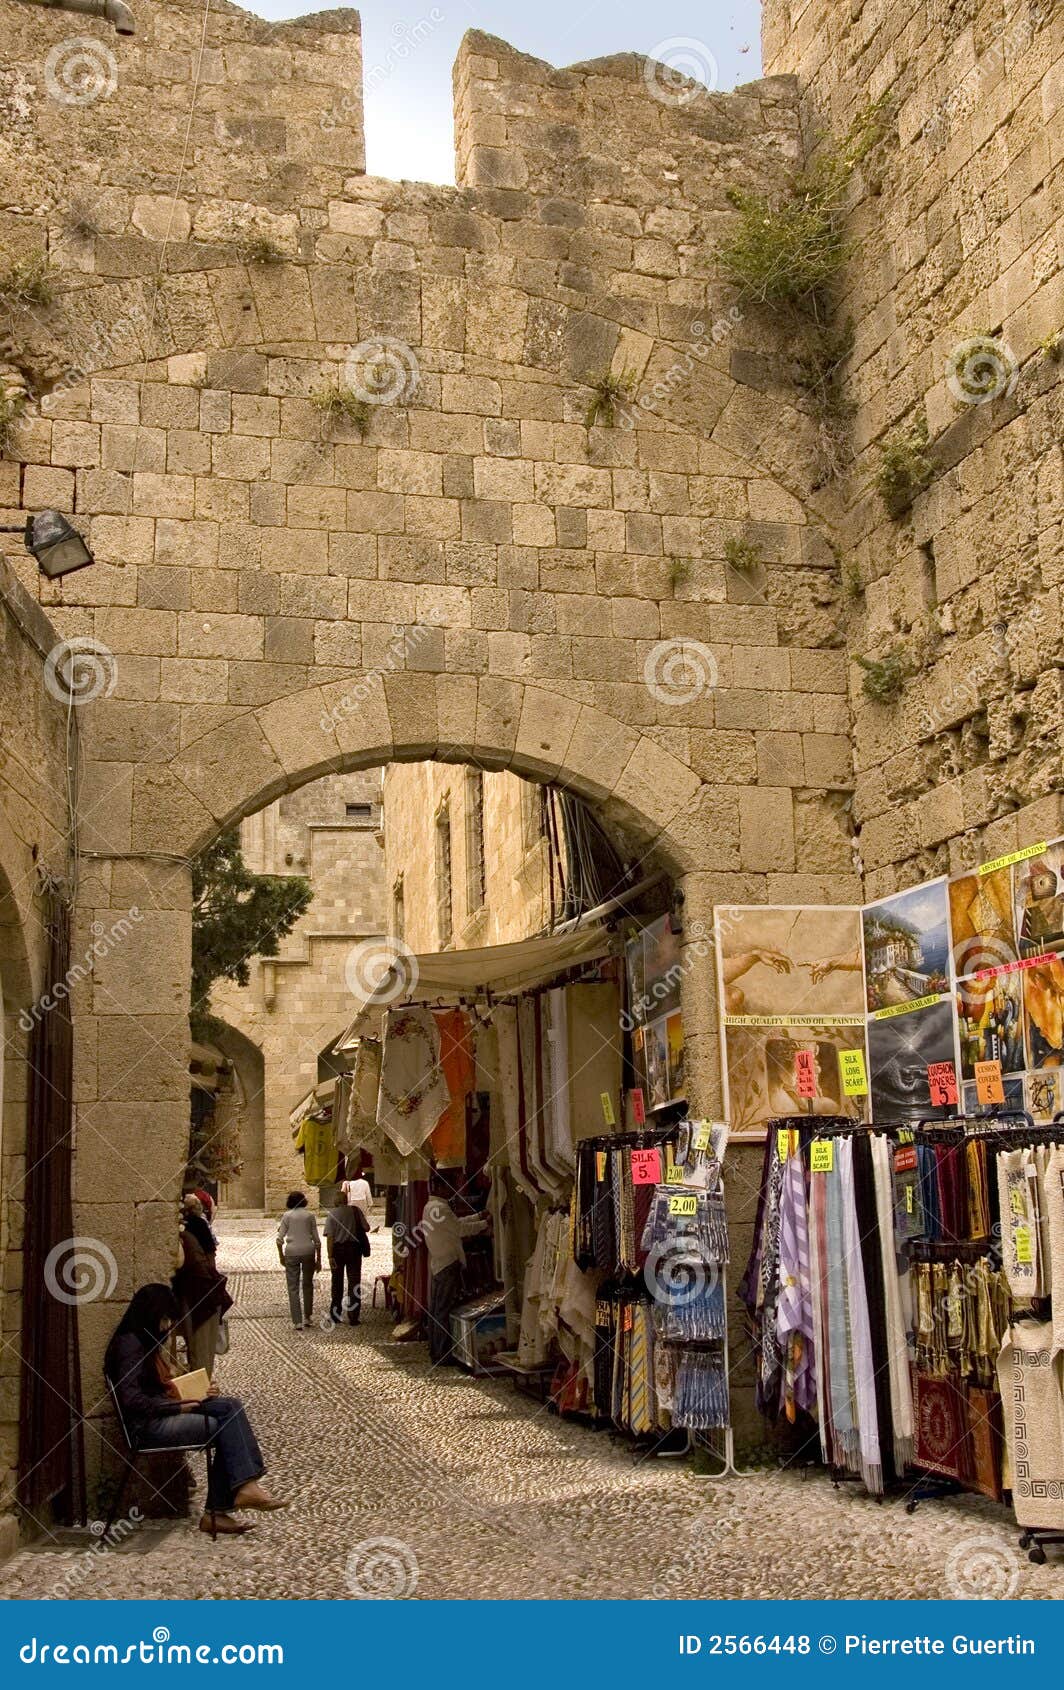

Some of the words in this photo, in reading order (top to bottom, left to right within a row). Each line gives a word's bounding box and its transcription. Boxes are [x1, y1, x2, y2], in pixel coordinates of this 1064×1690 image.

[726, 1016, 746, 1024] HIGH
[750, 1016, 783, 1026] QUALITY
[844, 1055, 858, 1064] SILK
[845, 1077, 864, 1088] SCARF
[631, 1152, 655, 1163] SILK
